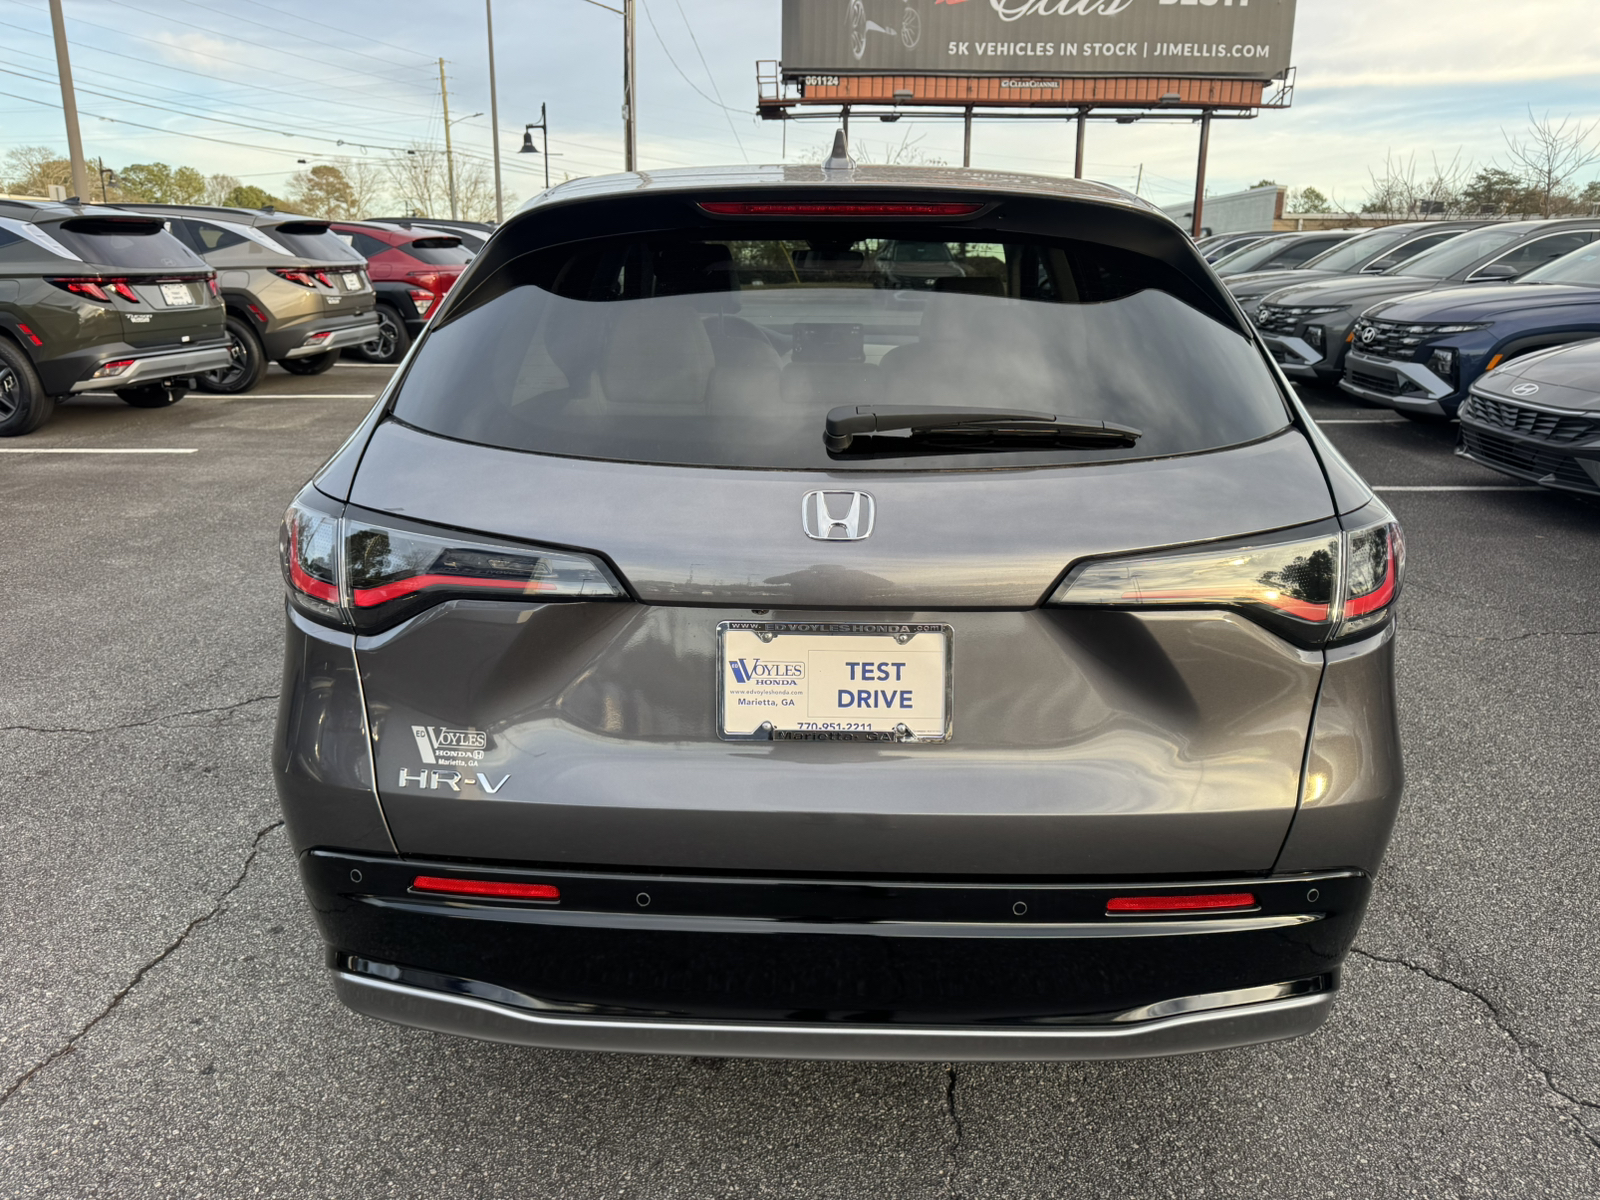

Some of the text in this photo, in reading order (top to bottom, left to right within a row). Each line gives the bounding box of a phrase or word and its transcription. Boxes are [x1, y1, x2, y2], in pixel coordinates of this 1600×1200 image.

[948, 41, 969, 56] 5K
[975, 42, 1054, 56] VEHICLES
[1060, 43, 1077, 56] IN
[1083, 43, 1137, 57] STOCK
[1153, 43, 1270, 58] JIMELLIS.COM
[738, 658, 803, 681] VOYLES
[845, 662, 906, 681] TEST
[737, 698, 796, 707] Marietta, GA
[837, 690, 914, 709] DRIVE
[797, 721, 873, 731] 770-951-2211
[415, 726, 486, 749] ED VOYLES
[866, 732, 893, 742] GA
[435, 750, 473, 758] HONDA
[438, 758, 479, 767] Marietta, GA
[398, 767, 512, 794] HR-V
